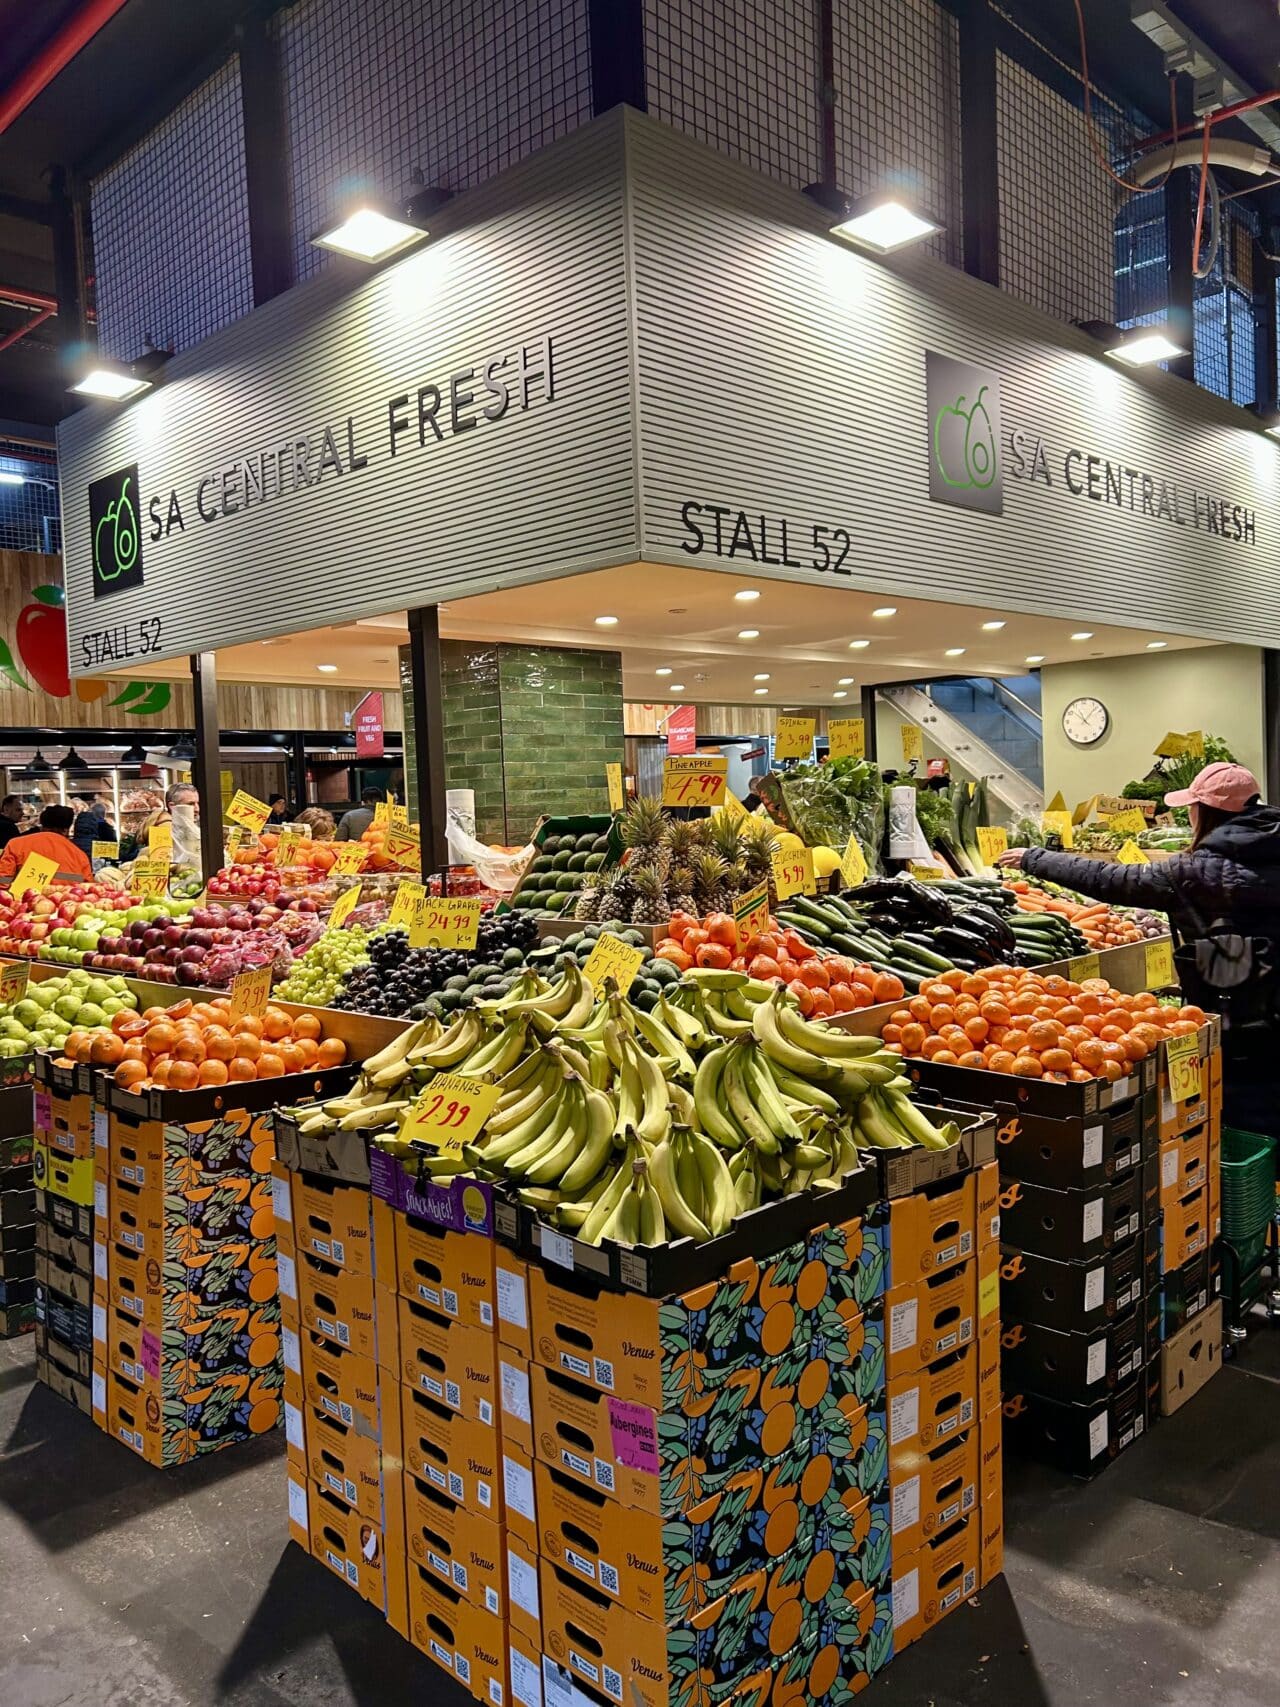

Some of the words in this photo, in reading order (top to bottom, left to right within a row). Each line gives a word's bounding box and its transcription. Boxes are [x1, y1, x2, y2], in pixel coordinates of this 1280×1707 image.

[149, 489, 184, 541] SA
[197, 418, 368, 523] CENTRAL
[389, 335, 555, 457] FRESH
[1011, 428, 1052, 486] SA
[1065, 449, 1186, 525] CENTRAL
[1194, 489, 1256, 546] FRESH
[681, 502, 801, 568] STALL
[813, 527, 852, 576] 52
[82, 625, 134, 667] STALL
[141, 617, 162, 654] 52
[666, 758, 713, 769] PINEAPPLE
[416, 898, 445, 913] BLACK
[448, 899, 480, 911] GRAPES
[599, 934, 637, 964] AVOCADO
[430, 1073, 482, 1096] BANANAS
[461, 1272, 487, 1287] Venus
[622, 1341, 656, 1360] Venus
[465, 1367, 490, 1383] Venus
[467, 1459, 493, 1476] Venus
[470, 1552, 495, 1571] Venus
[626, 1553, 660, 1575] Venus
[474, 1645, 499, 1666] Venus
[631, 1658, 664, 1683] Venus
